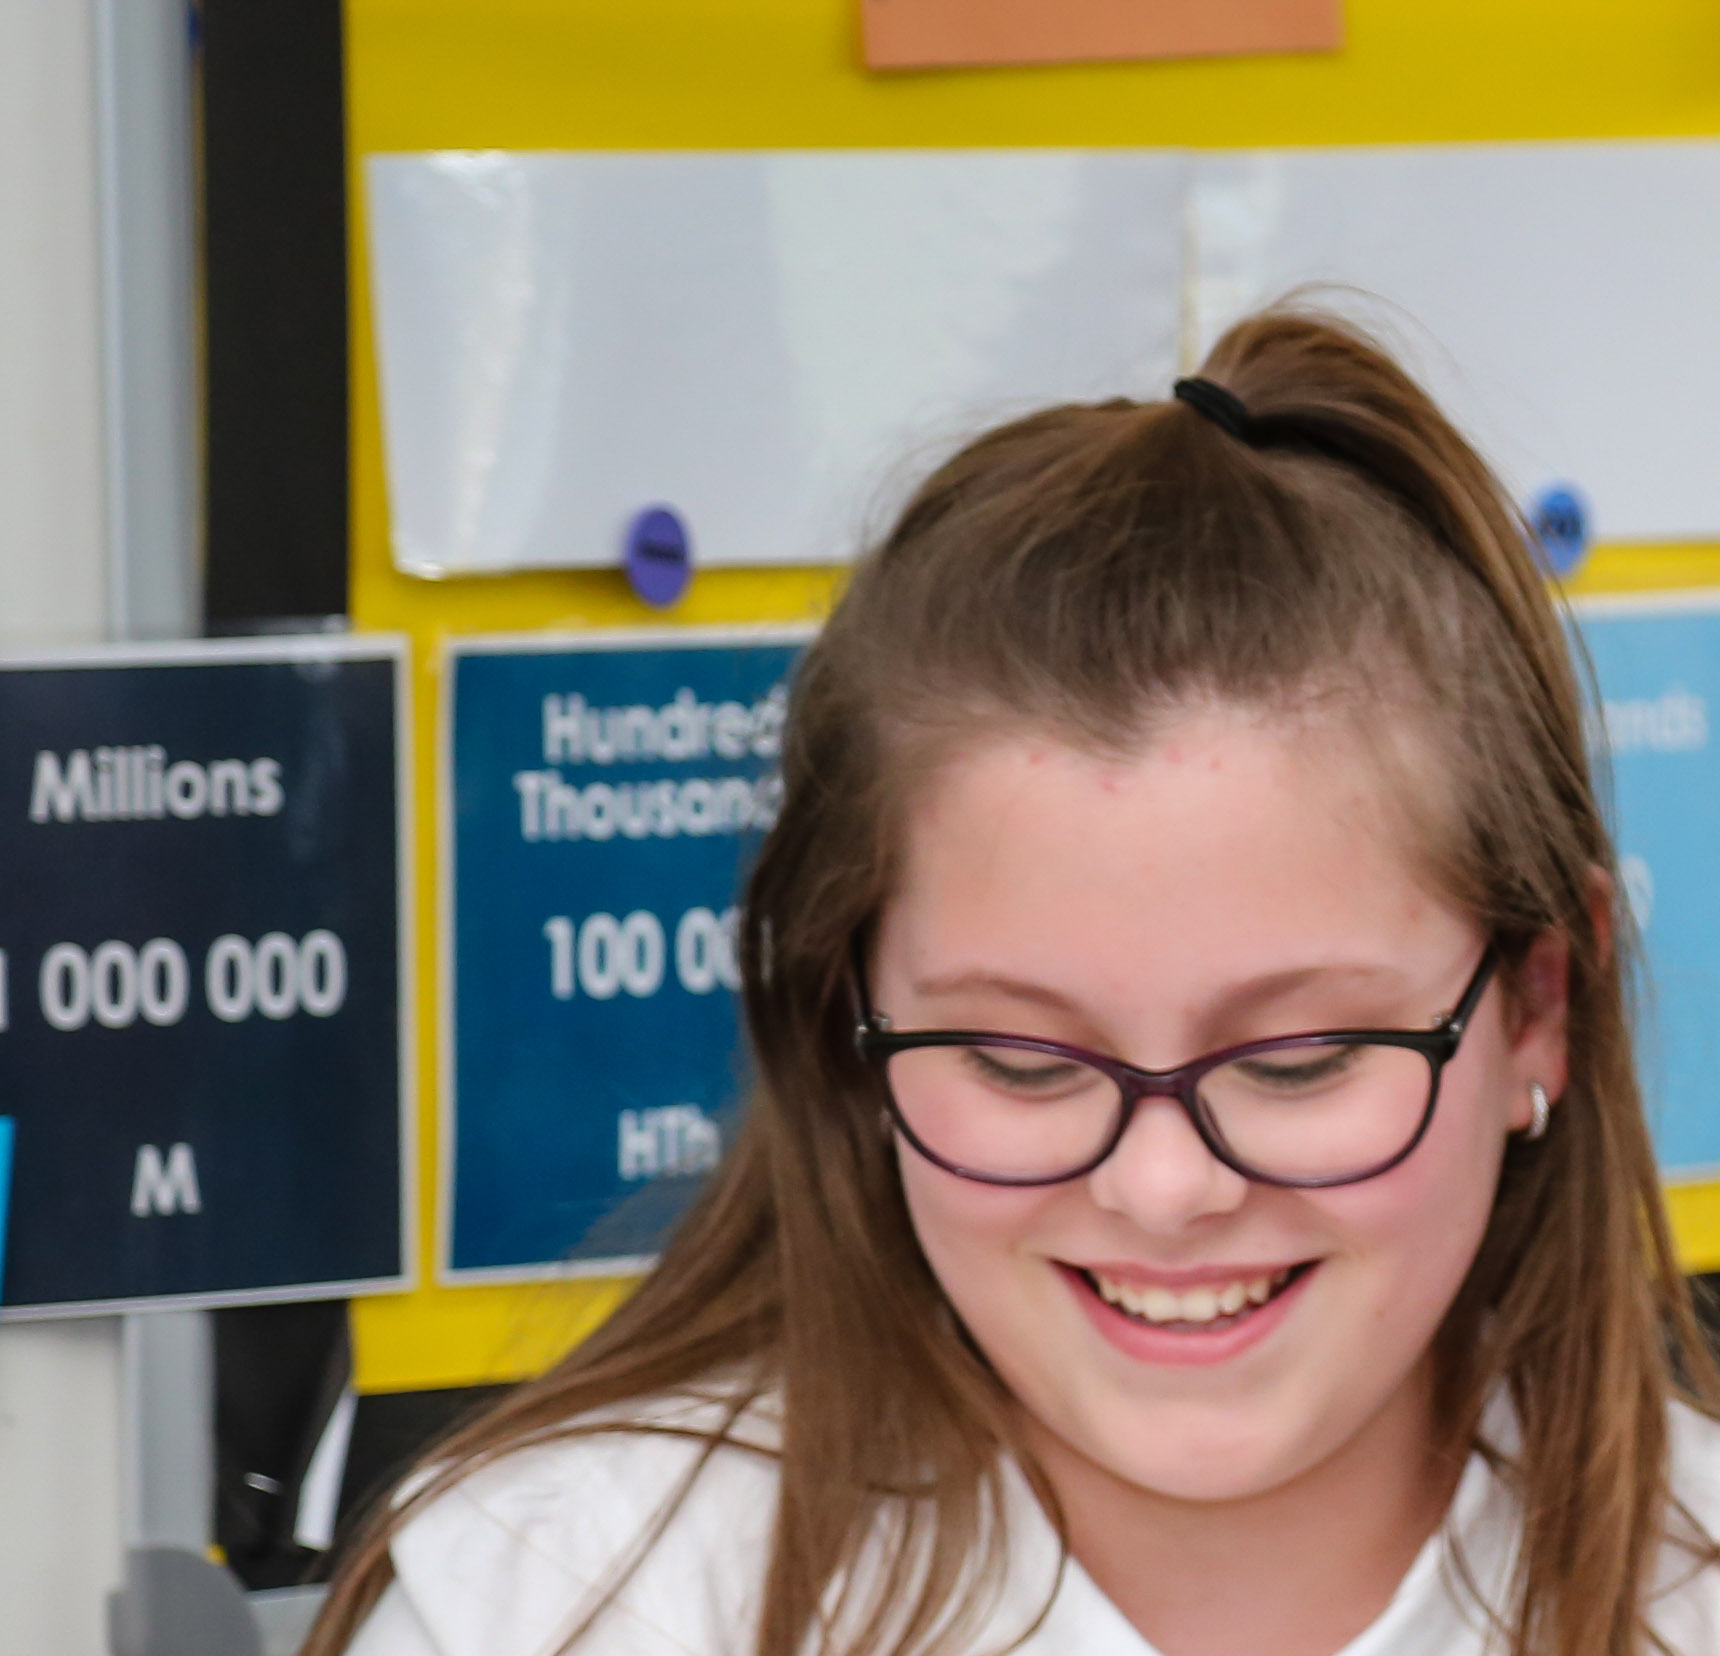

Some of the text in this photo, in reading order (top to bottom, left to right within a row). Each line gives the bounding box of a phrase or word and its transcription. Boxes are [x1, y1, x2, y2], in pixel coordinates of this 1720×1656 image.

[30, 744, 284, 823] Millions
[39, 937, 189, 1031] 000
[205, 929, 347, 1022] 000
[543, 906, 744, 1000] 100 00
[131, 1142, 201, 1218] M
